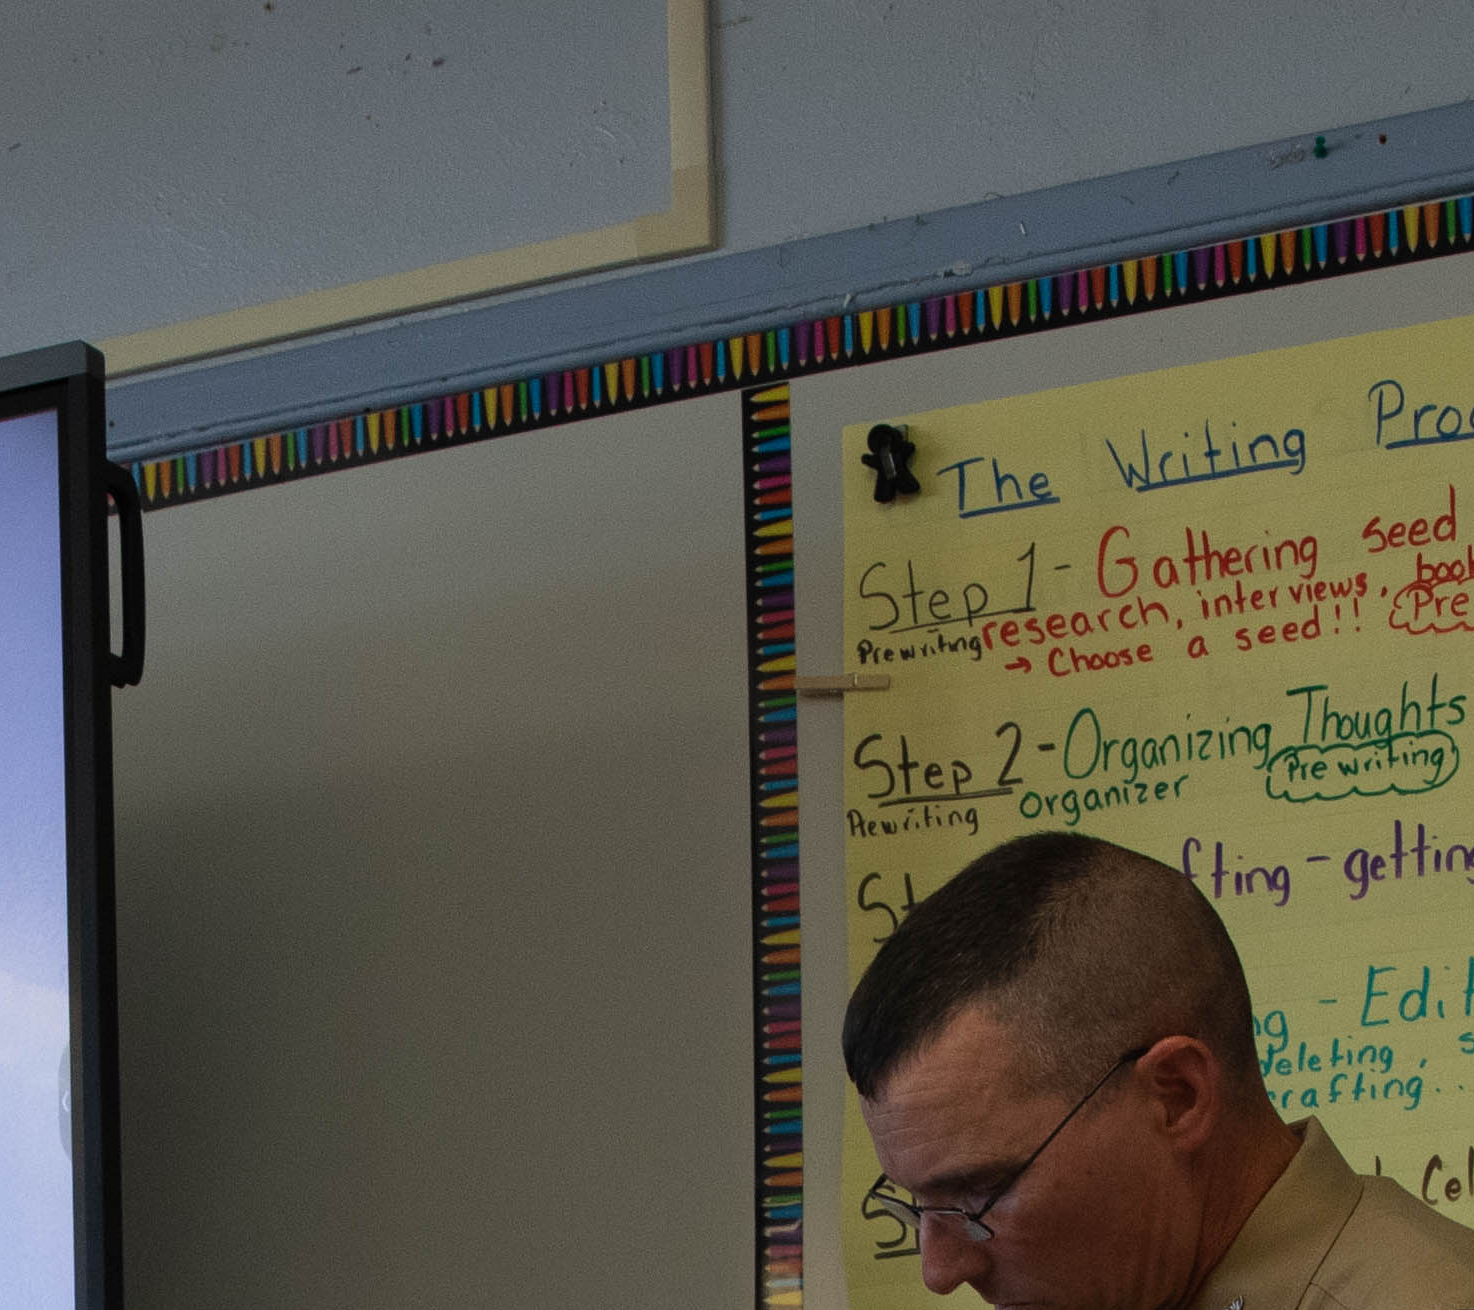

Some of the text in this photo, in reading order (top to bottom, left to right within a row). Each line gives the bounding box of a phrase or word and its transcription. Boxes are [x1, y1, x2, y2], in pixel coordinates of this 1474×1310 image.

[937, 455, 1054, 512] The
[1106, 418, 1306, 488] Writing
[859, 559, 990, 631] Step
[1098, 525, 1319, 598] Gathering
[1362, 484, 1457, 553] seed
[982, 598, 1184, 651] research,
[1048, 644, 1154, 677] Choose
[1187, 635, 1210, 660] a
[854, 734, 973, 799] Step
[996, 721, 1024, 787] 2
[1064, 707, 1272, 785] Organizing
[1286, 672, 1467, 748] Thoughts
[1019, 774, 1190, 827] organizer
